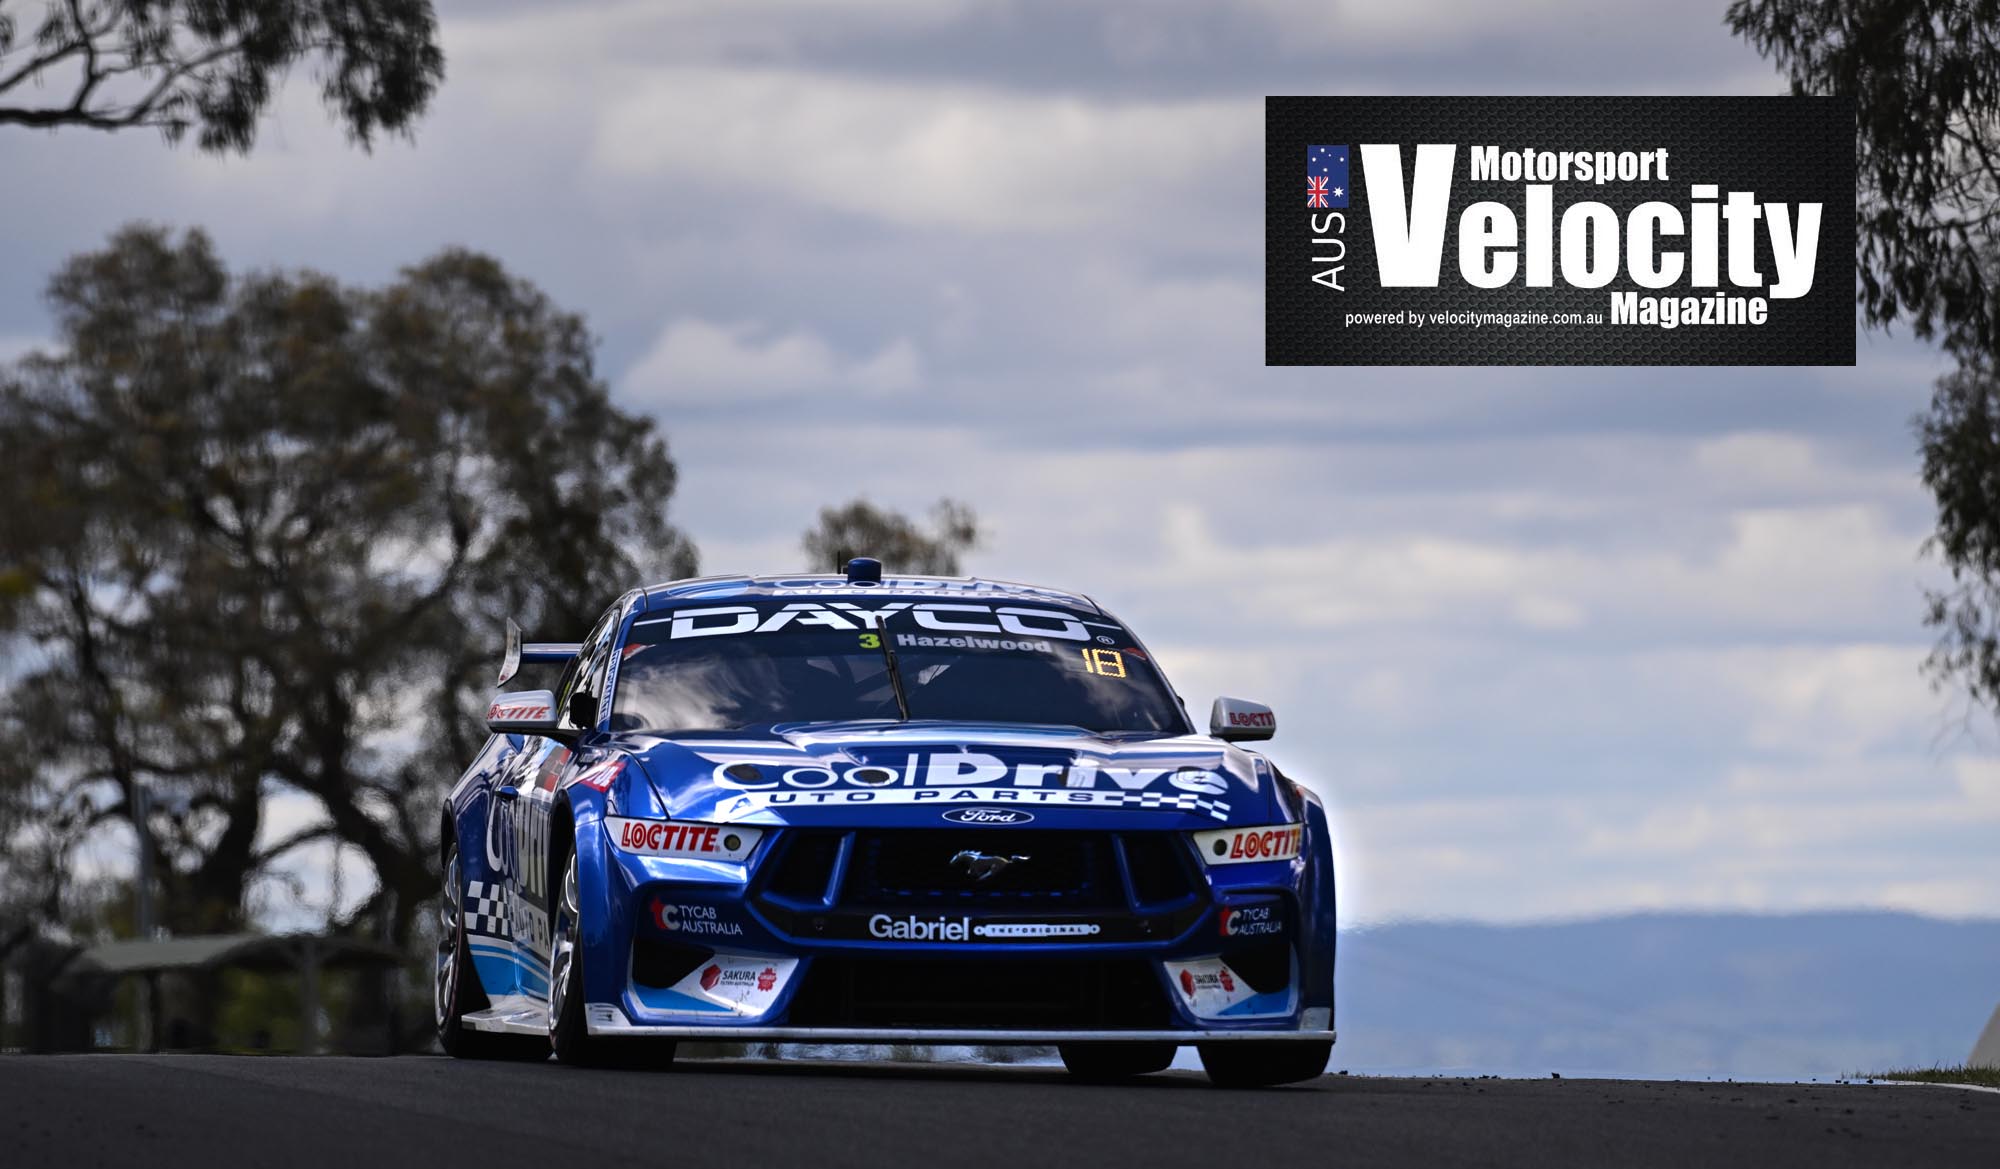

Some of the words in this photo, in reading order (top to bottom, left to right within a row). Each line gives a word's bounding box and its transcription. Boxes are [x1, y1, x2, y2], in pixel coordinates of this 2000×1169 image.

[670, 602, 1091, 641] DAYCO
[858, 633, 881, 649] 3
[896, 633, 1052, 652] Hazelwood
[1082, 647, 1127, 679] 18
[713, 752, 1229, 795] CoolDrive
[729, 791, 876, 814] AUTO
[913, 789, 1095, 803] PARTS
[960, 808, 1016, 823] Ford
[621, 822, 721, 853] LOCTITE
[679, 904, 717, 920] TYCAB
[1242, 908, 1271, 921] TYCAB
[681, 920, 744, 936] AUSTRALIA
[868, 913, 971, 941] Gabriel
[990, 926, 1014, 934] THE
[1021, 926, 1083, 934] ORIGINAL
[1237, 920, 1283, 936] AUSTRALIA
[722, 970, 756, 982] SAKURA
